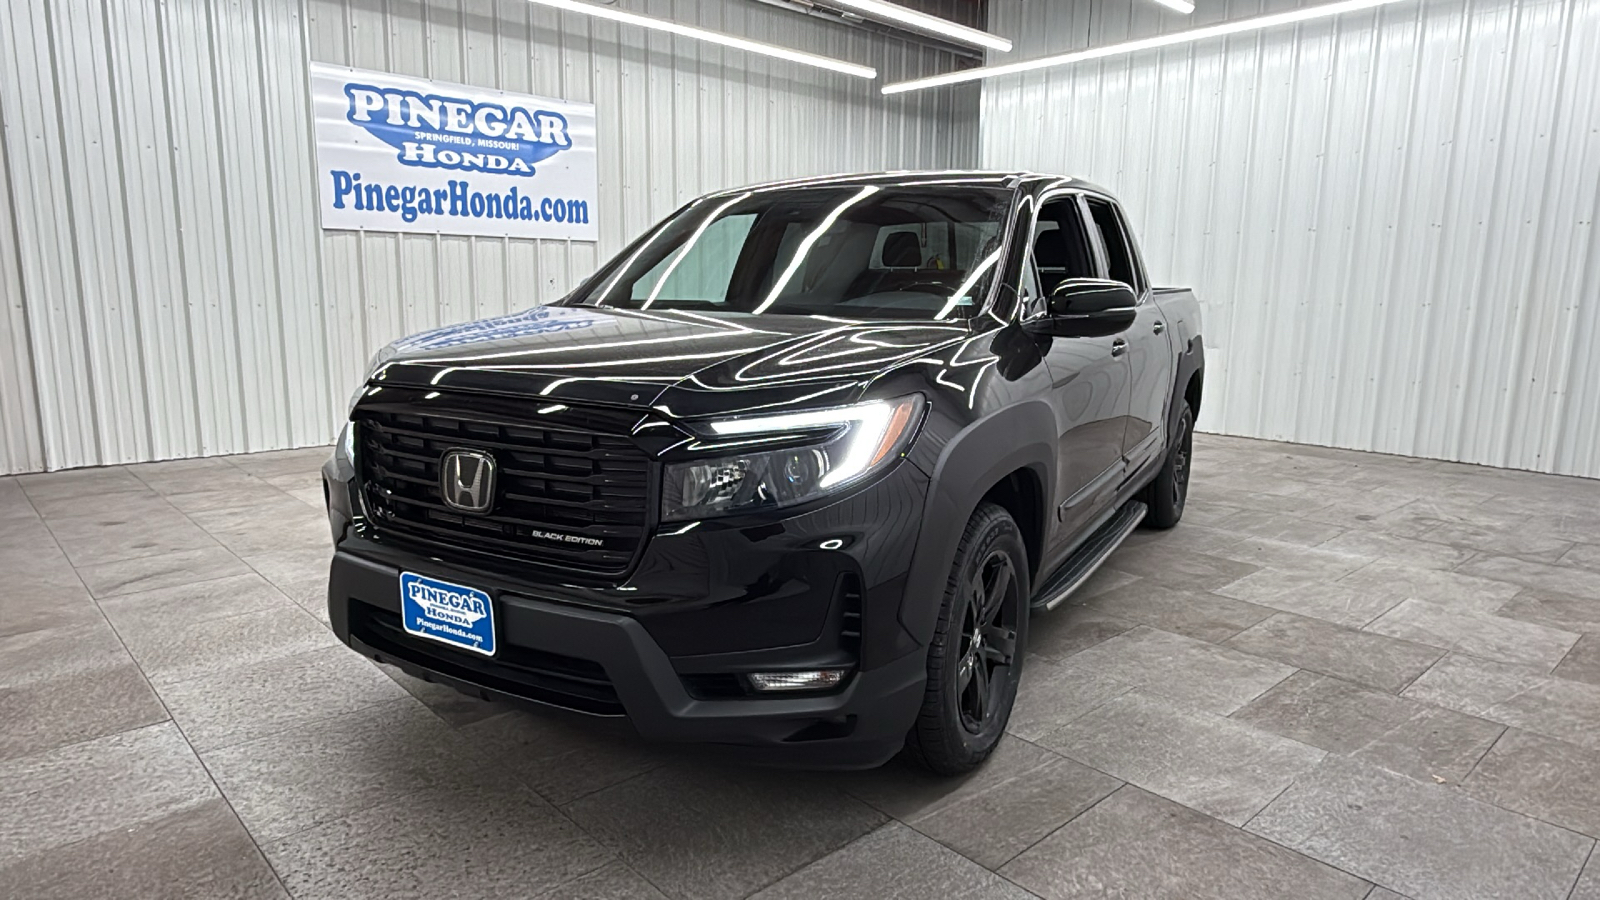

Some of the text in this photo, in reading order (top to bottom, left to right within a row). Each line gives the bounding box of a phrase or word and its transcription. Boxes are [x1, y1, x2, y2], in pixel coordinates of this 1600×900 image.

[349, 88, 569, 146] PINEGAR
[414, 131, 520, 151] SPRINGFIELD, MISSOURI
[402, 141, 532, 173] HONDA
[330, 170, 590, 224] PinegarHonda.com
[531, 530, 604, 546] BLACK EDITION
[410, 584, 485, 616] PINEGAR
[416, 617, 483, 643] PinegarHonda.com
[426, 606, 471, 626] HONDA
